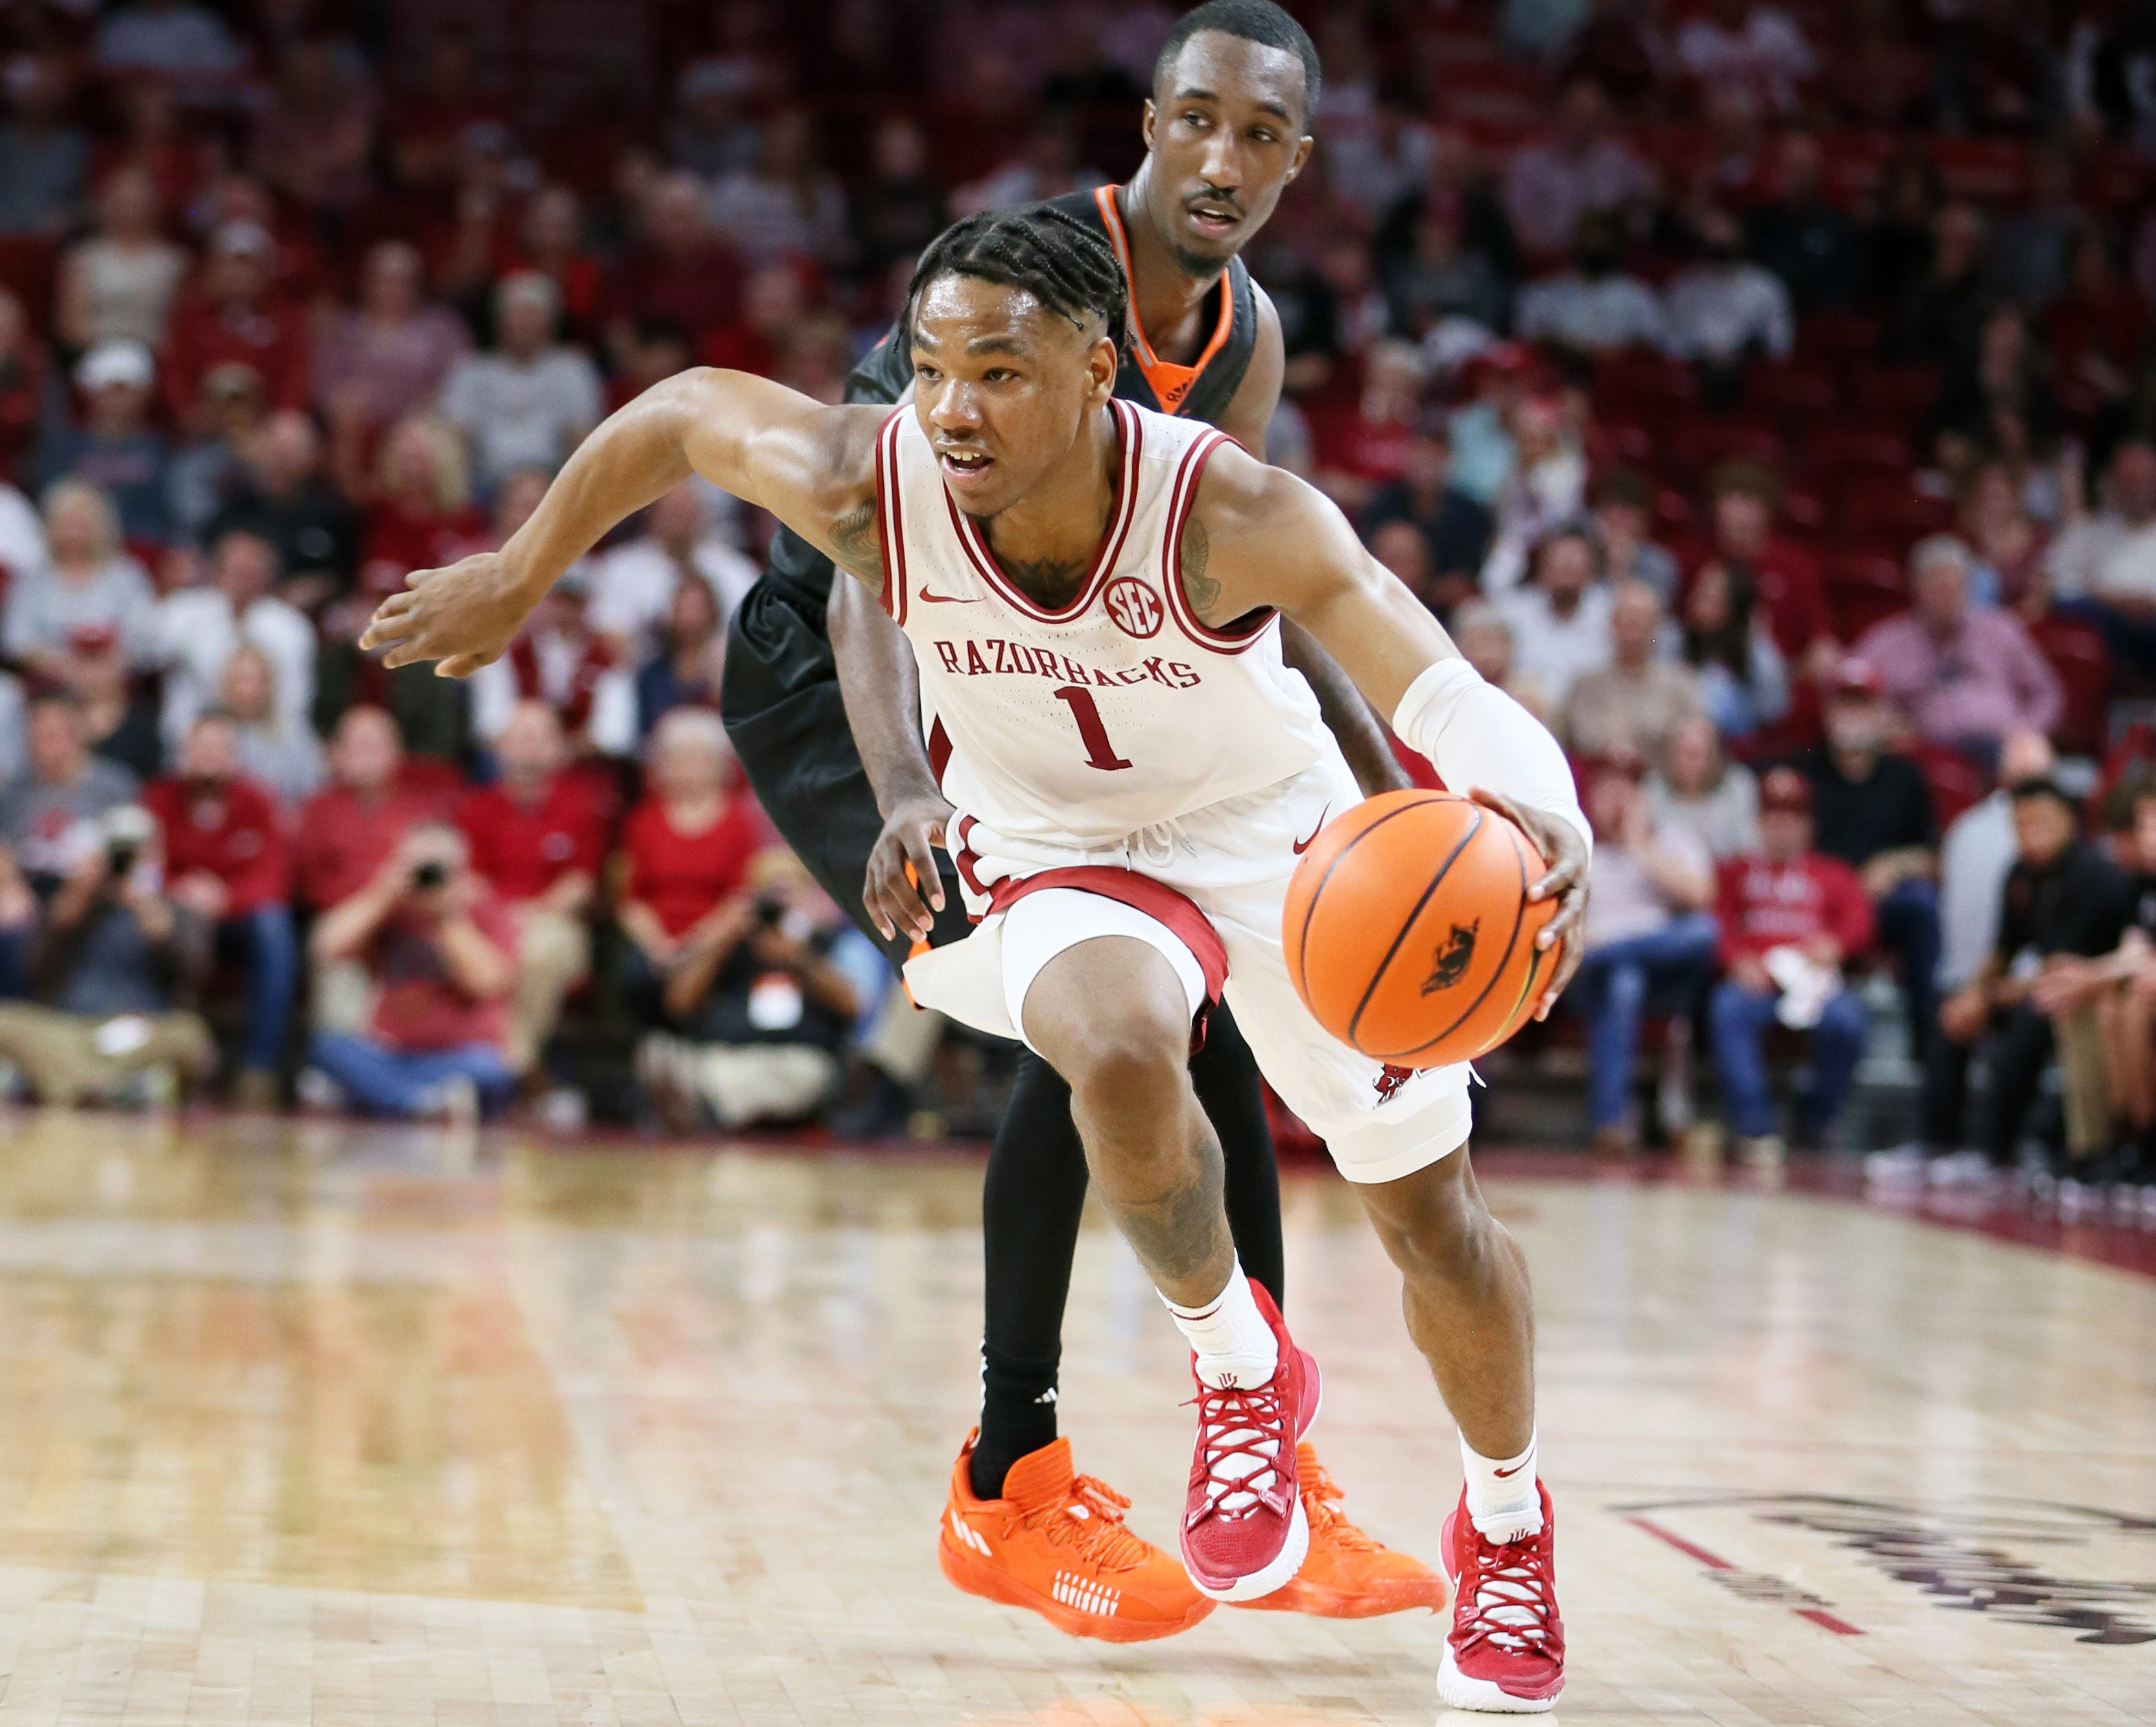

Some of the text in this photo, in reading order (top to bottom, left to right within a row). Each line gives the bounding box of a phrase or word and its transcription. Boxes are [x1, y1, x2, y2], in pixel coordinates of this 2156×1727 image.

[1108, 582, 1159, 635] SEC
[934, 639, 1202, 689] RAZORBACKS
[1054, 686, 1133, 770] 1
